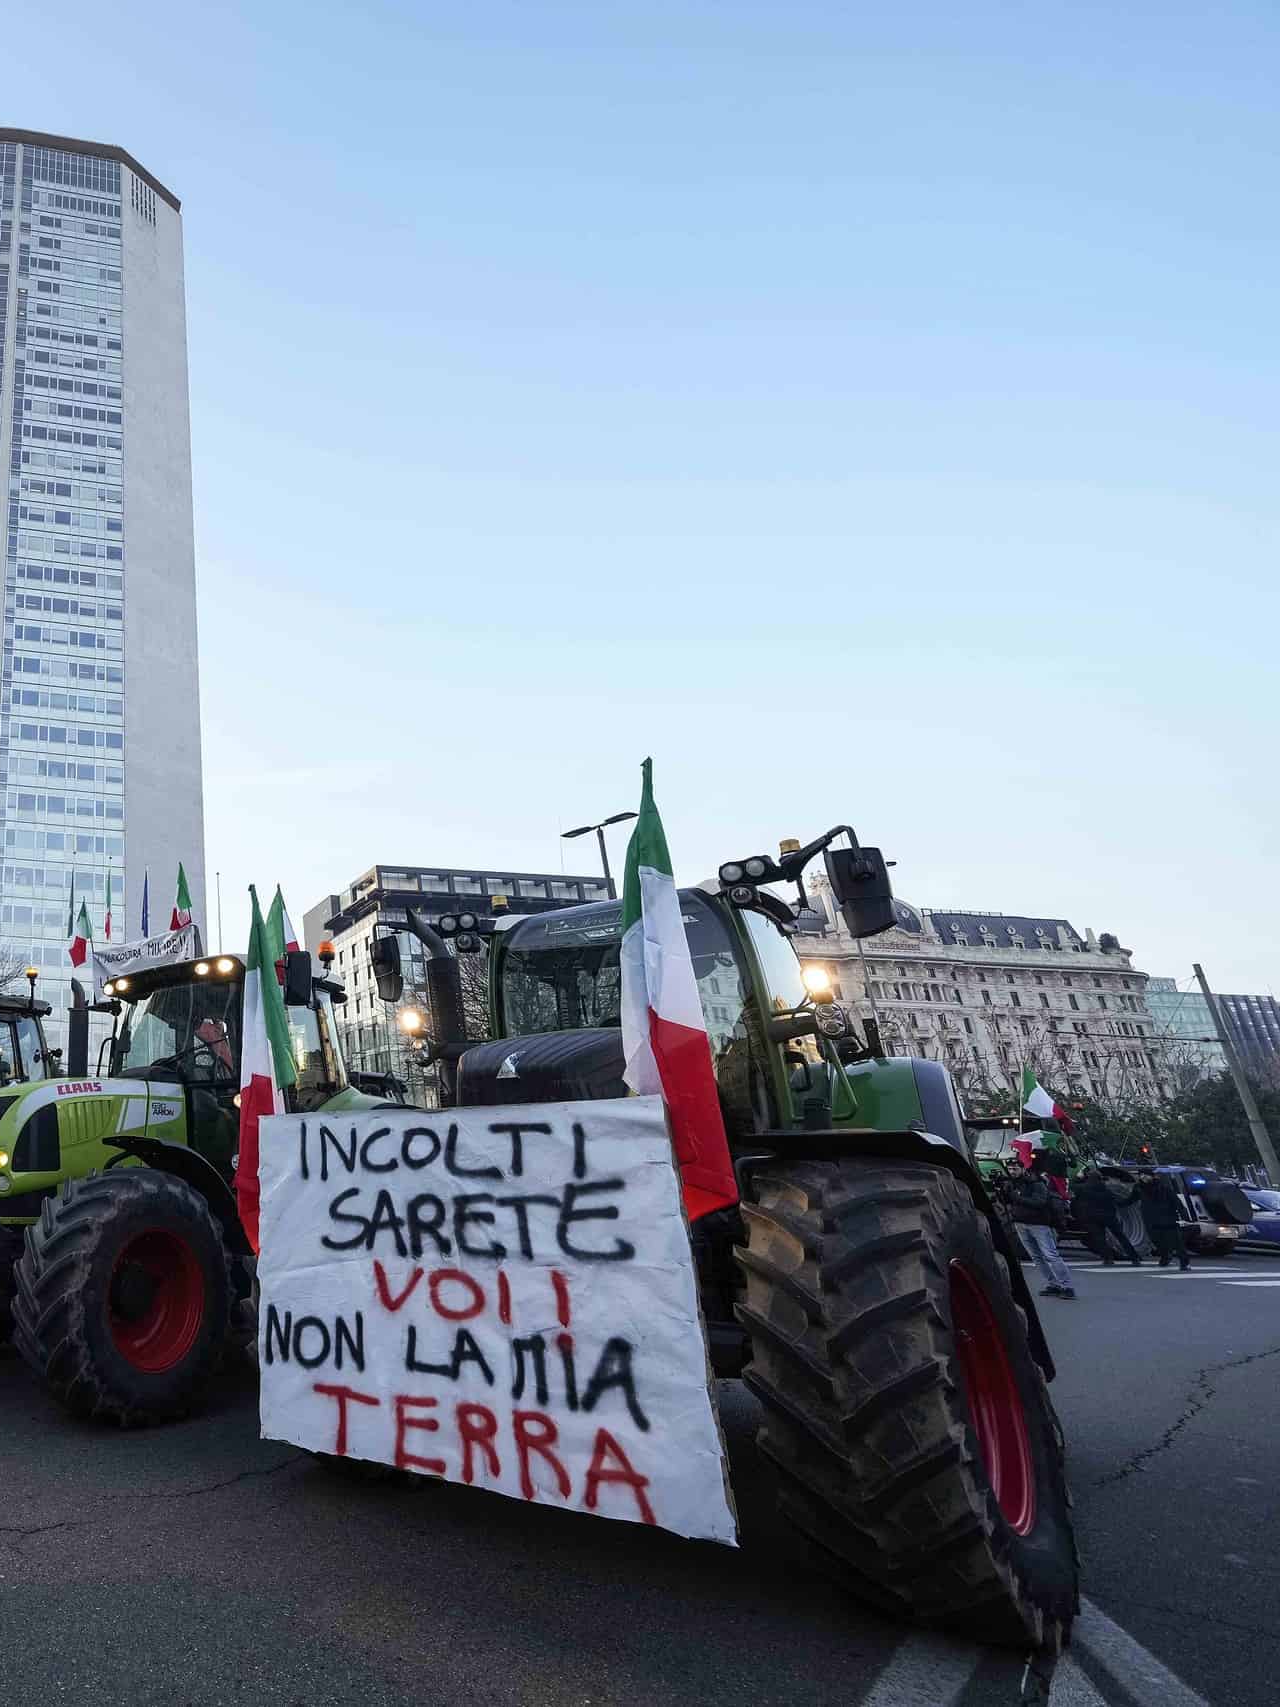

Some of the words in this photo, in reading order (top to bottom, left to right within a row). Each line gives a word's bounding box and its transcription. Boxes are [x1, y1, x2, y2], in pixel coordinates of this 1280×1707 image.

[56, 1082, 103, 1096] CLAAS
[299, 1121, 587, 1181] INCOLTI
[320, 1179, 636, 1261] SARETE
[264, 1303, 365, 1372] NON
[404, 1325, 495, 1386] LA
[512, 1336, 652, 1432] MIA
[313, 1383, 658, 1525] TERRA
